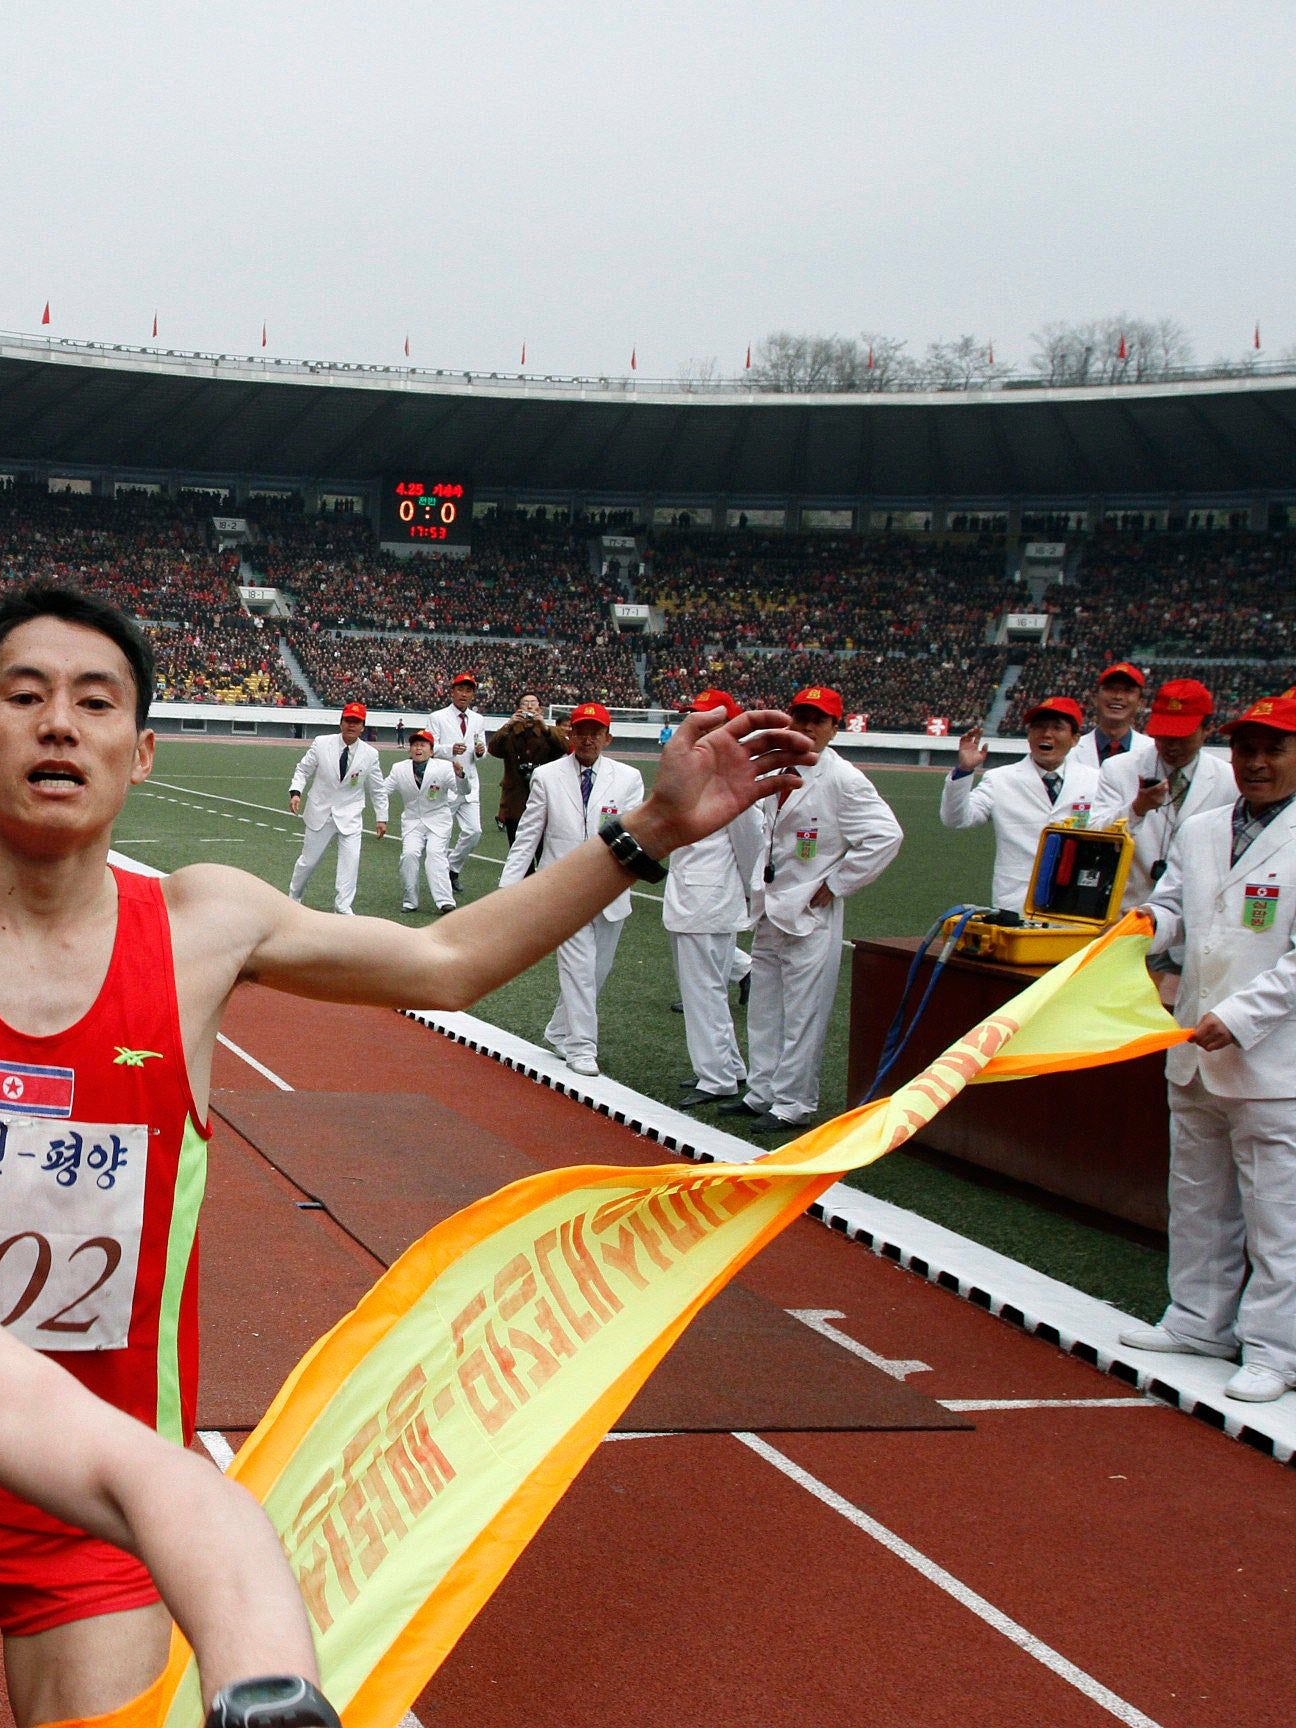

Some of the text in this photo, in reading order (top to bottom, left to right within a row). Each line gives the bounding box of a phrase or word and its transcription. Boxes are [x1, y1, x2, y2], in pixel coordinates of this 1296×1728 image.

[395, 482, 424, 496] 4.25
[218, 521, 237, 530] 18-2
[409, 526, 448, 539] 17:53
[247, 590, 264, 600] 18-1
[621, 608, 639, 617] 17-1
[1016, 617, 1037, 627] 16-1
